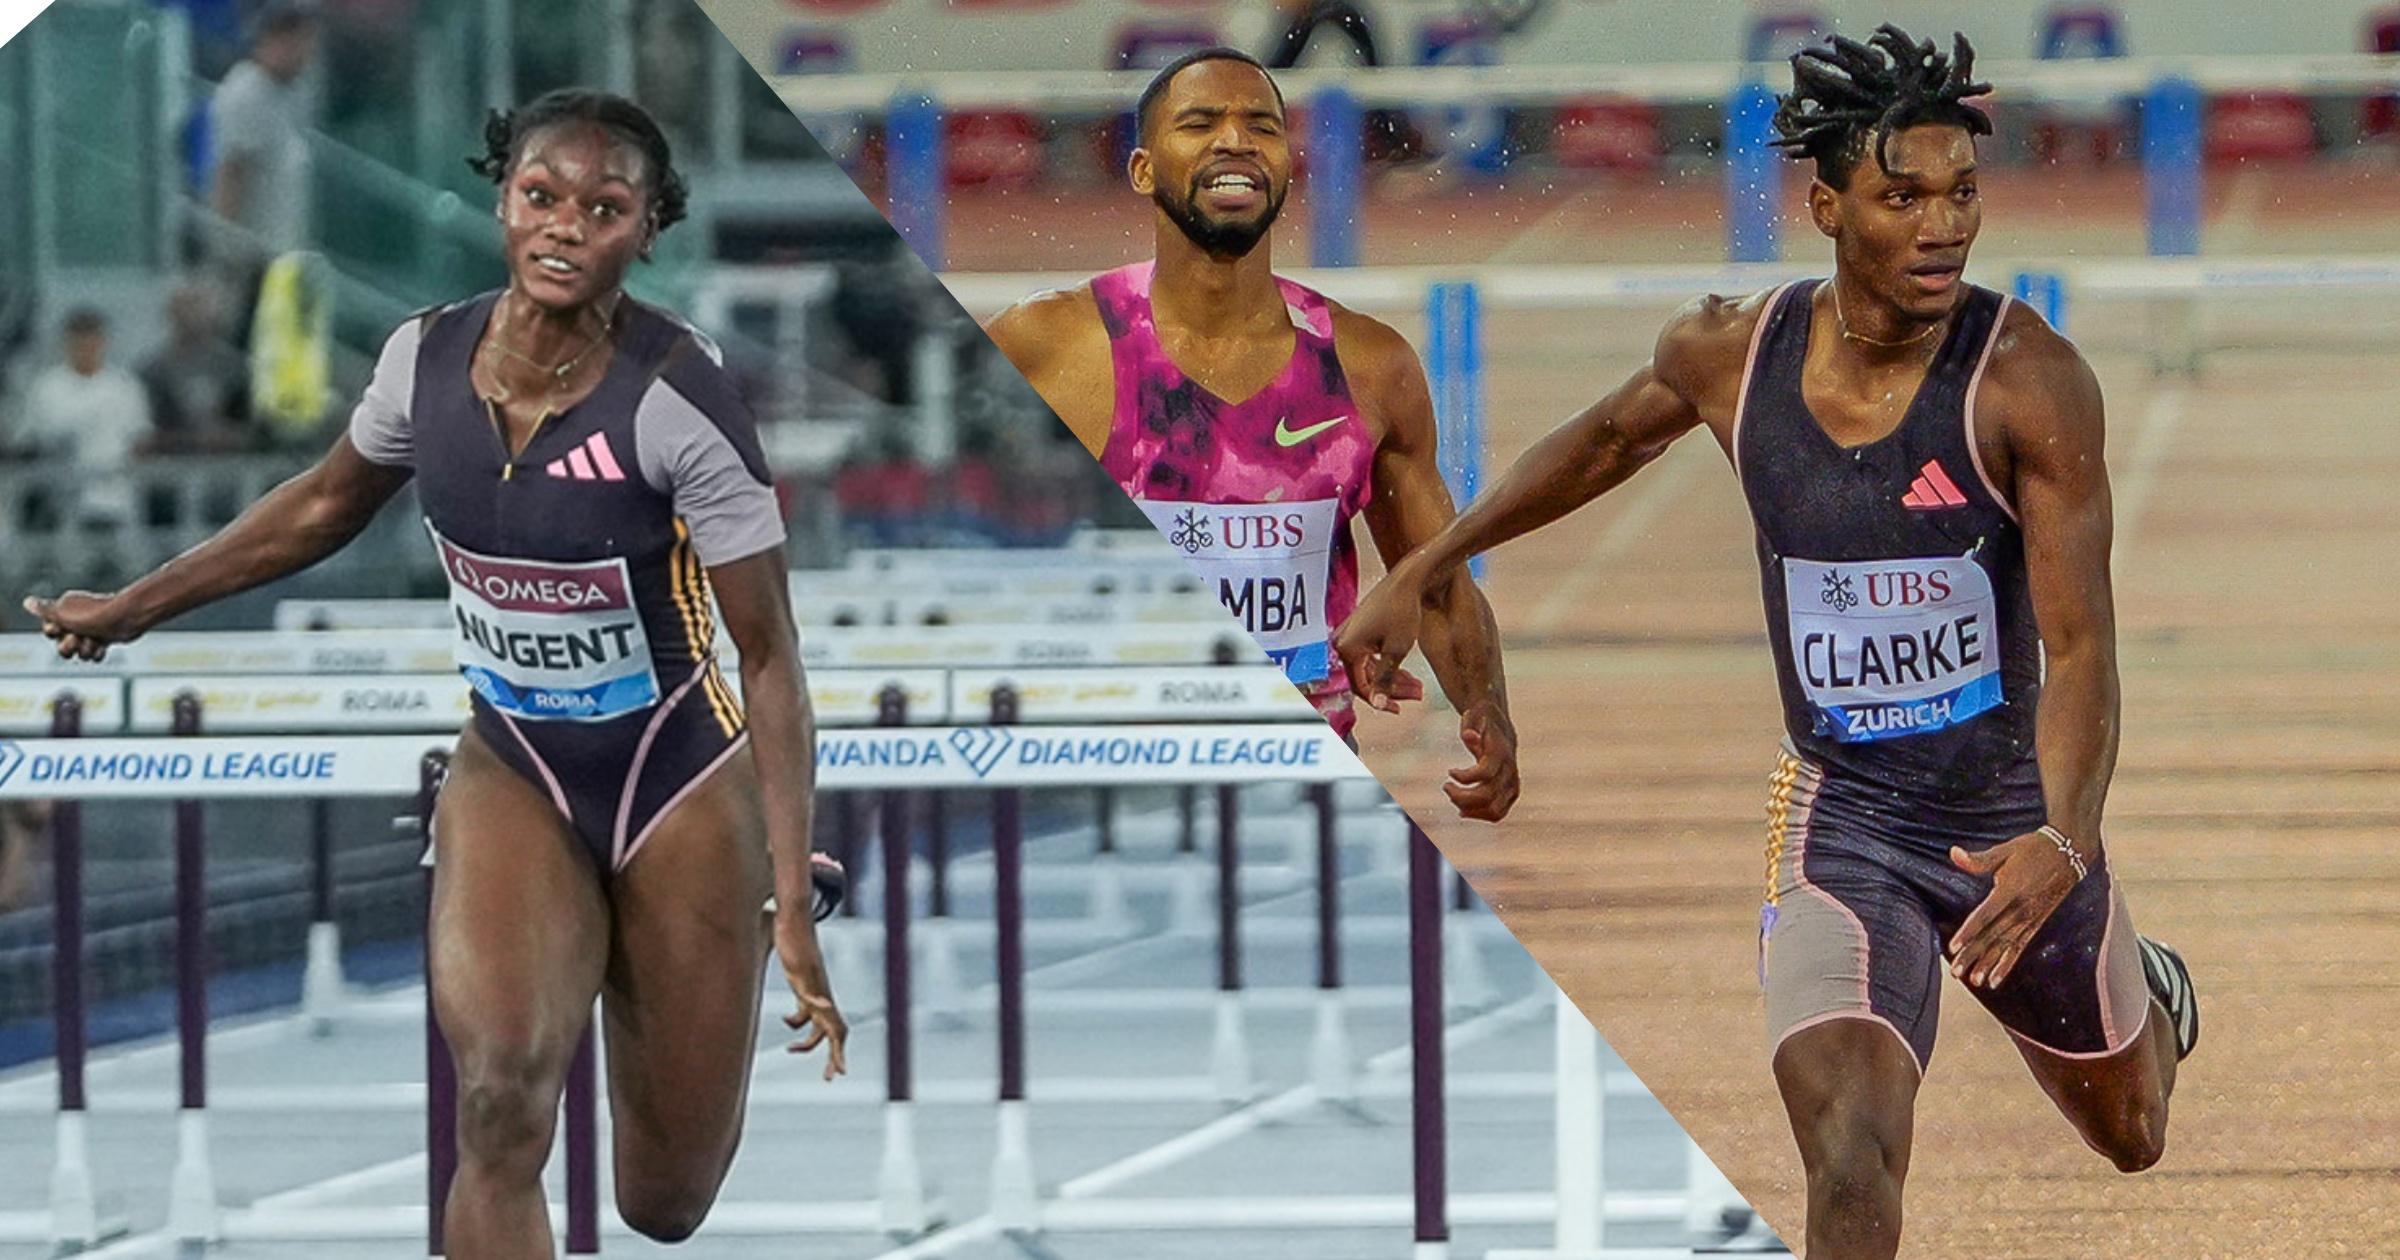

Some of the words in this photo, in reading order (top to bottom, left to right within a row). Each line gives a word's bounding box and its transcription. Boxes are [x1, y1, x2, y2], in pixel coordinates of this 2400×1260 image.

[1219, 514, 1304, 549] UBS
[485, 575, 611, 605] OMEGA
[1217, 573, 1309, 634] MBA
[1864, 569, 1953, 608] UBS
[456, 603, 636, 670] NUGENT
[1803, 612, 1983, 689] CLARKE
[342, 688, 430, 712] ROMA
[534, 692, 598, 709] ROMA
[1160, 681, 1247, 704] ROMA
[1846, 697, 1951, 735] ZURICH
[29, 752, 193, 782] DIAMOND
[202, 751, 337, 780] LEAGUE
[816, 738, 945, 767] WANDA
[1018, 738, 1180, 765] DIAMOND
[1189, 737, 1322, 765] LEAGUE
